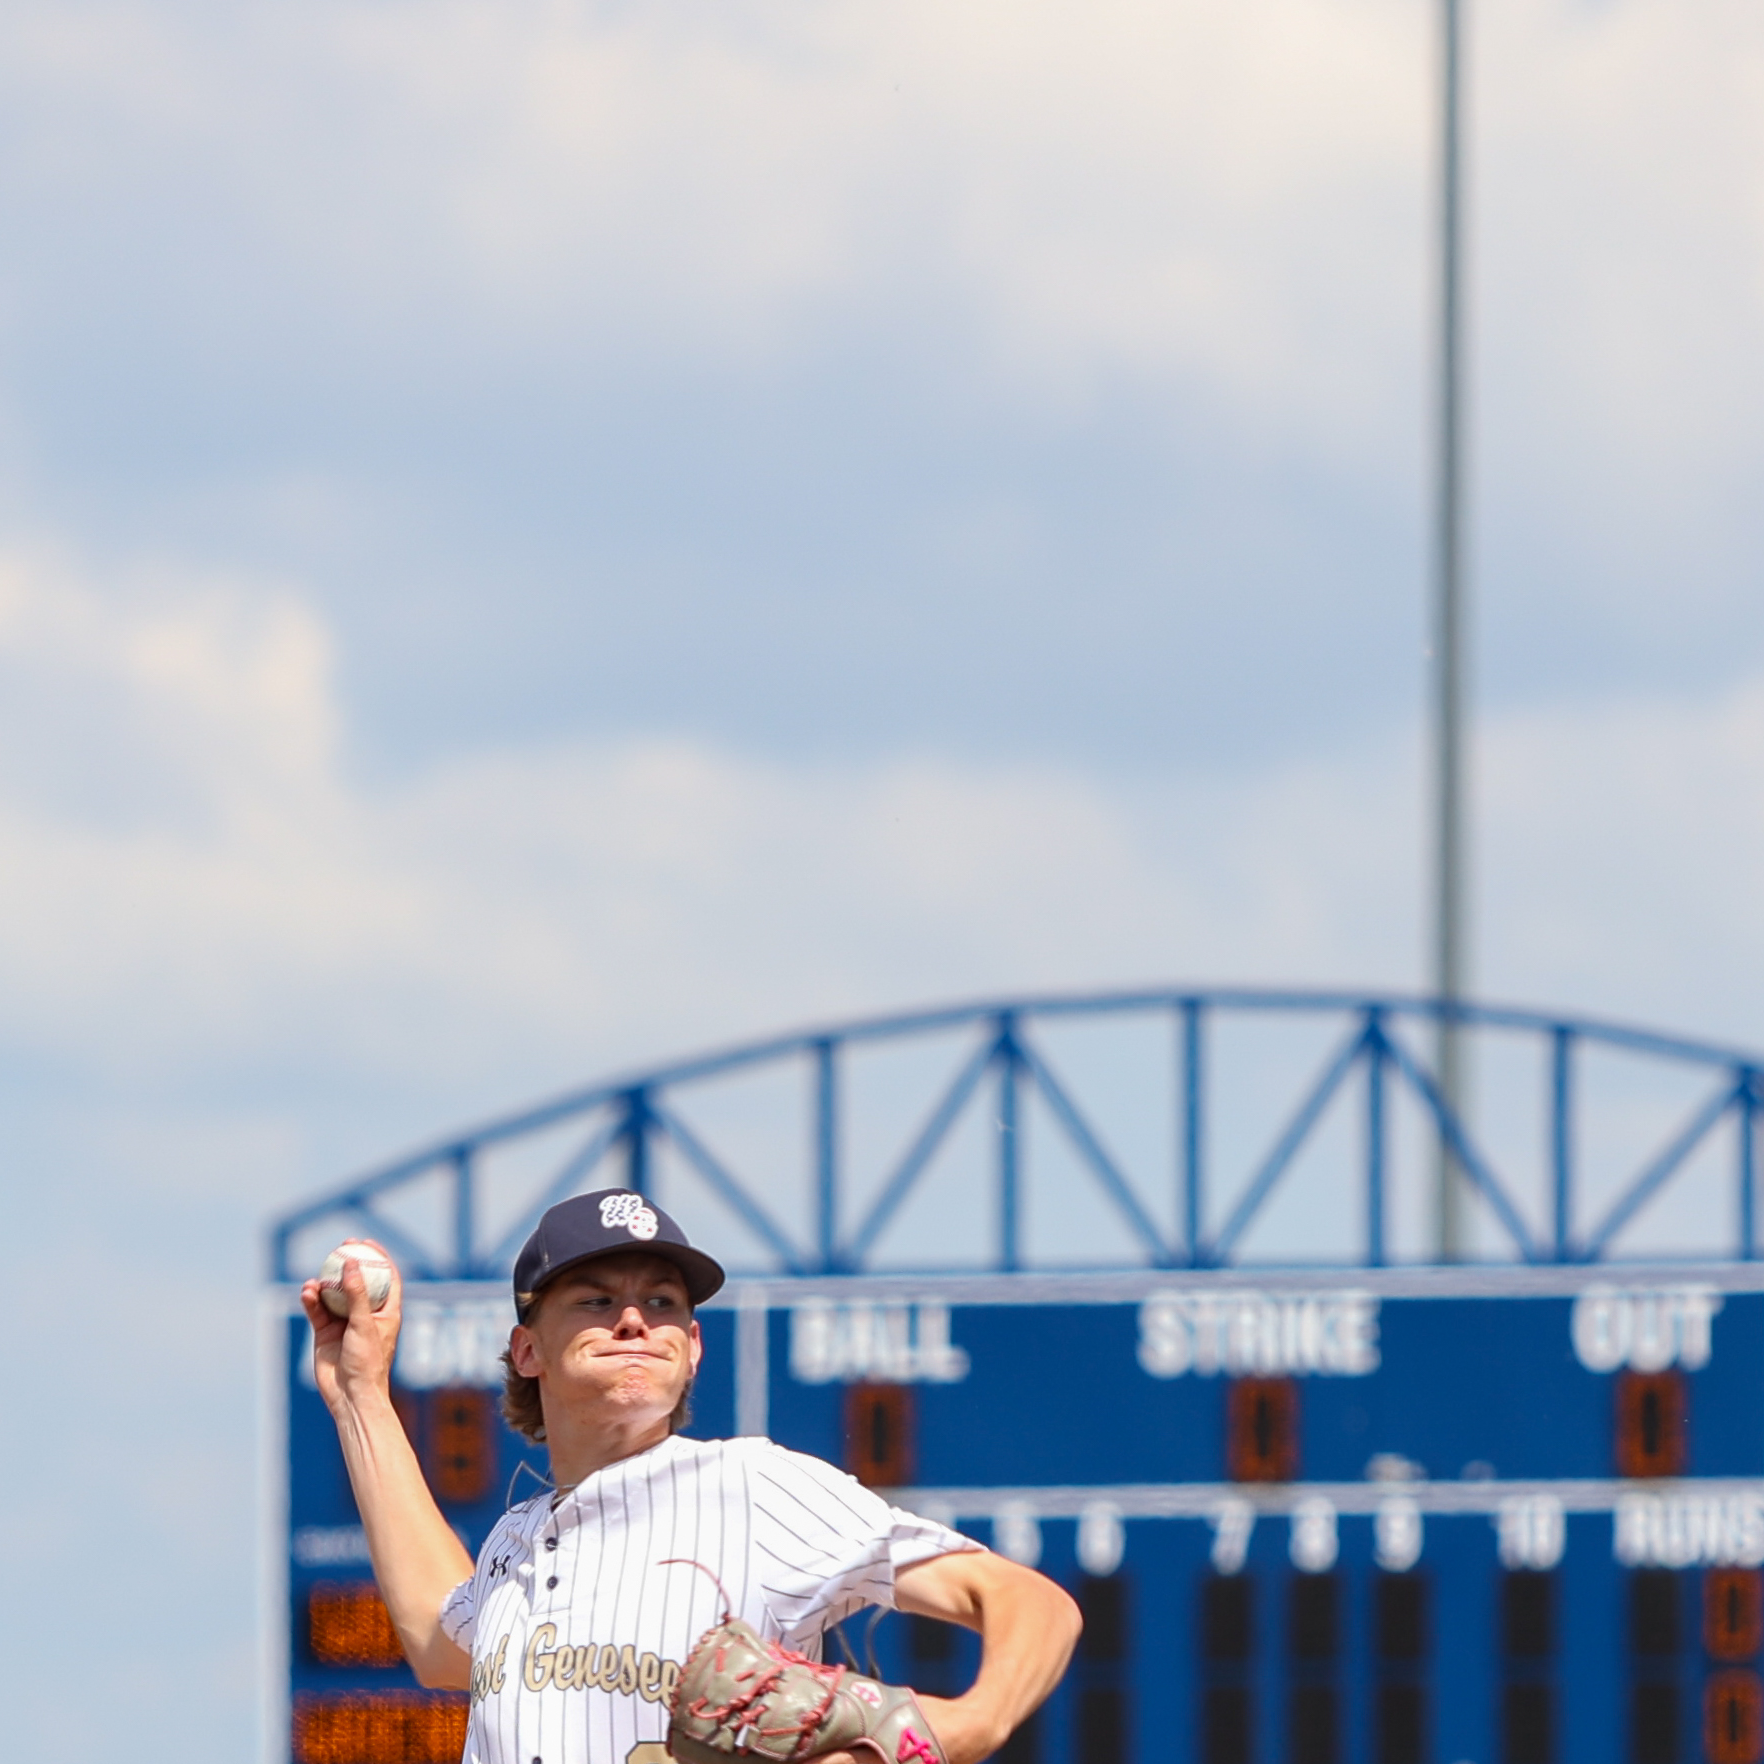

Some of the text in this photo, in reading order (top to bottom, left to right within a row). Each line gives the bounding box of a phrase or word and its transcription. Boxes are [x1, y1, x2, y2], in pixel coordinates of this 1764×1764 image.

[790, 1299, 971, 1384] BALL
[1138, 1290, 1382, 1378] STRIKE
[1571, 1283, 1724, 1373] OUT
[846, 1384, 916, 1486] 0
[1226, 1376, 1299, 1484] 0
[1614, 1367, 1686, 1479] 0
[1208, 1499, 1255, 1576] 7
[1495, 1496, 1566, 1571] 10
[1704, 1566, 1764, 1661] 0
[472, 1622, 682, 1712] est Genesee
